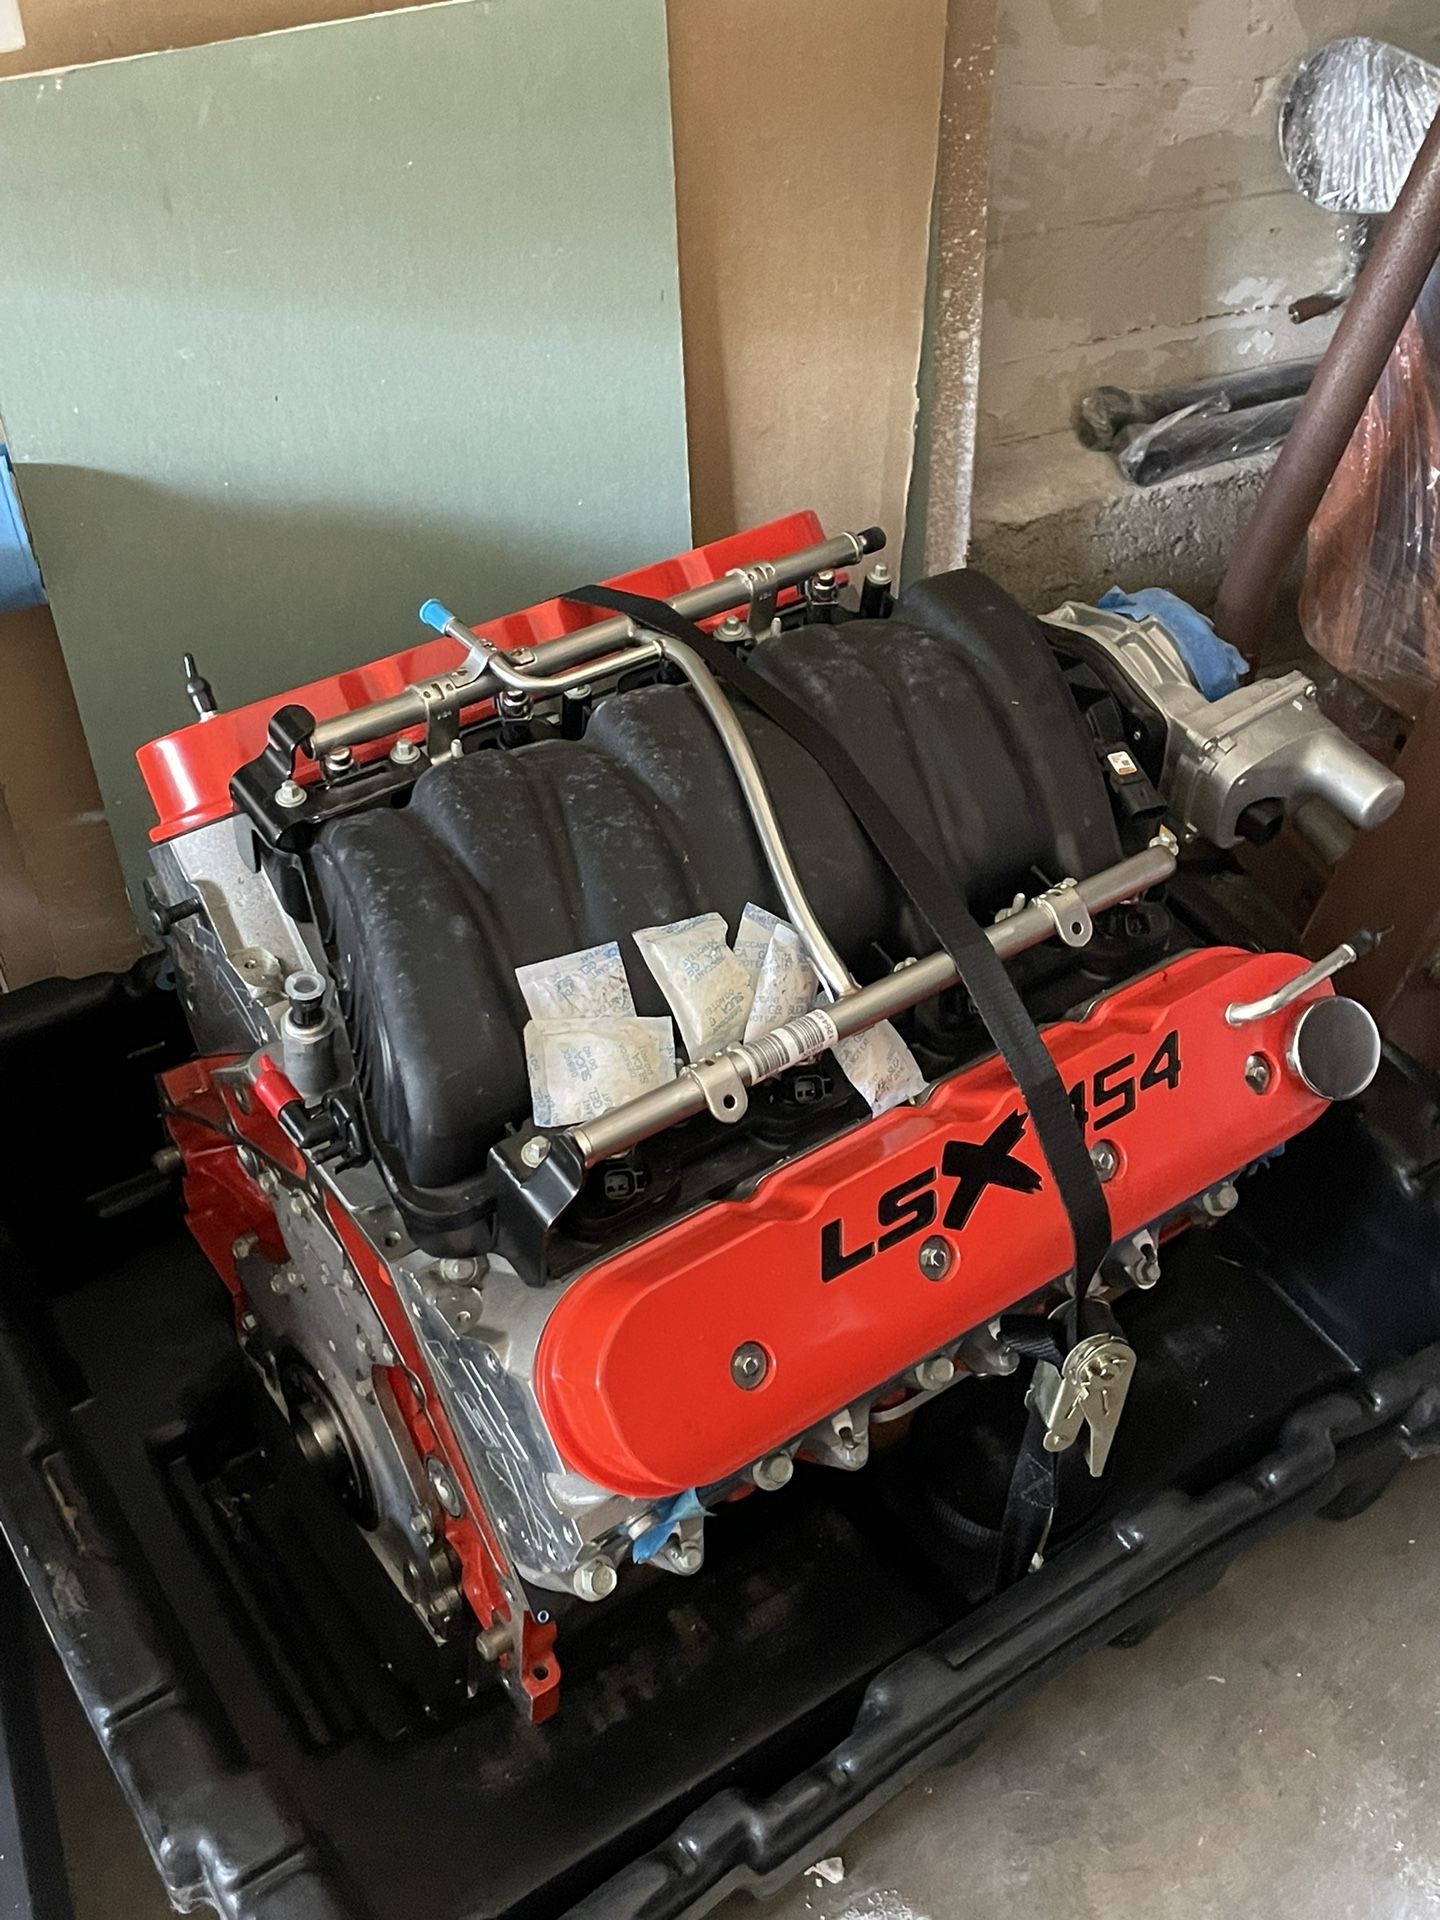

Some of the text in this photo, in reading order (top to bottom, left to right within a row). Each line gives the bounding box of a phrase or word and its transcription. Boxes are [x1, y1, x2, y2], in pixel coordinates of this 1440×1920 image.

[586, 1086, 603, 1109] GEL
[821, 1108, 1043, 1283] LSX
[423, 1341, 560, 1552] LSX
